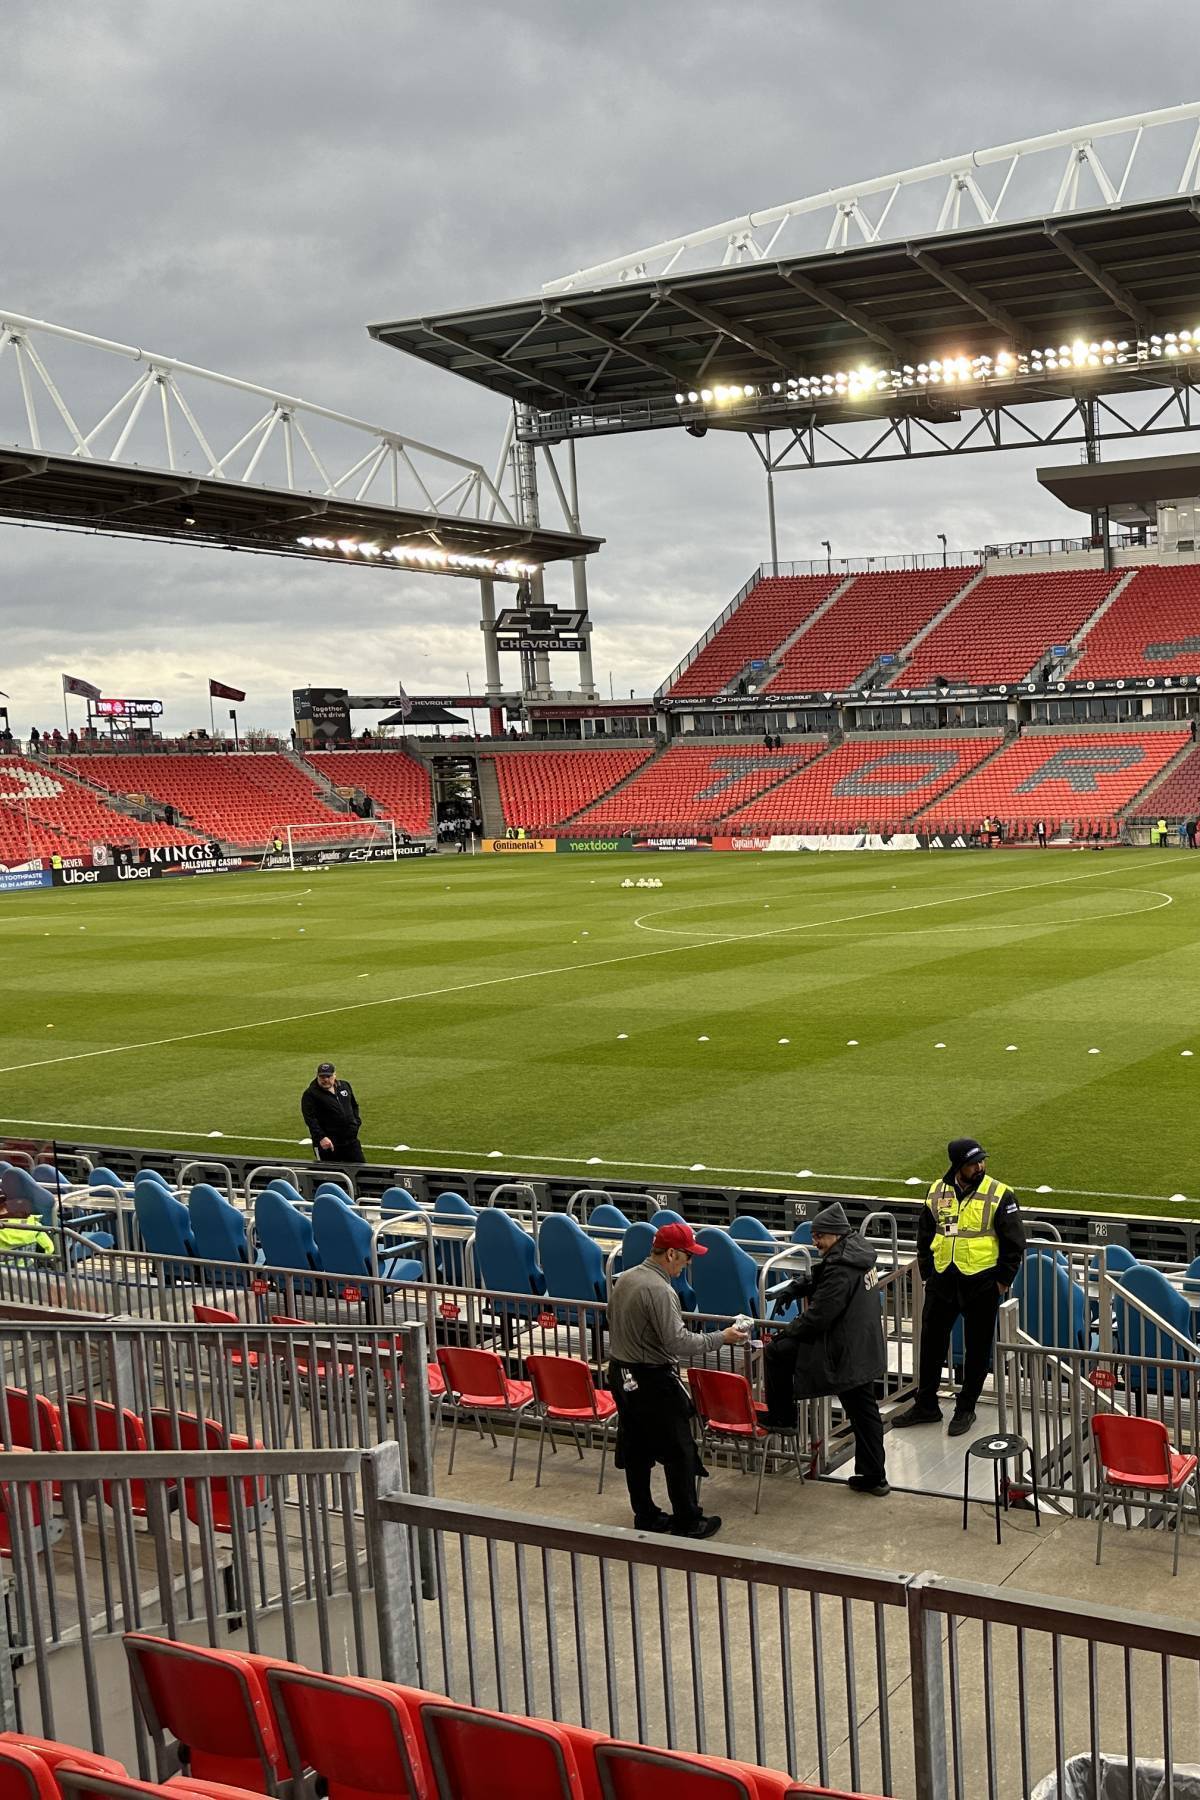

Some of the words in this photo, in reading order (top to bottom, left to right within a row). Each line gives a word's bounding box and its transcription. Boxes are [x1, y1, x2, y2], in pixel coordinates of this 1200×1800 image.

[500, 640, 584, 649] CHEVROLET
[136, 704, 152, 712] NYC
[312, 706, 343, 714] Together
[493, 840, 537, 851] Continental
[570, 840, 619, 851] nextdoor
[647, 838, 677, 846] FALLSVIEW
[731, 837, 753, 850] Captain
[149, 843, 214, 863] KINGS
[375, 846, 425, 857] CHEVROLET
[181, 859, 218, 870] FALLSVIEW
[218, 857, 242, 866] CASINO
[5, 872, 43, 881] TOOTHPASTE
[62, 869, 100, 884] Uber
[117, 865, 152, 880] Uber
[1095, 1223, 1107, 1237] 28
